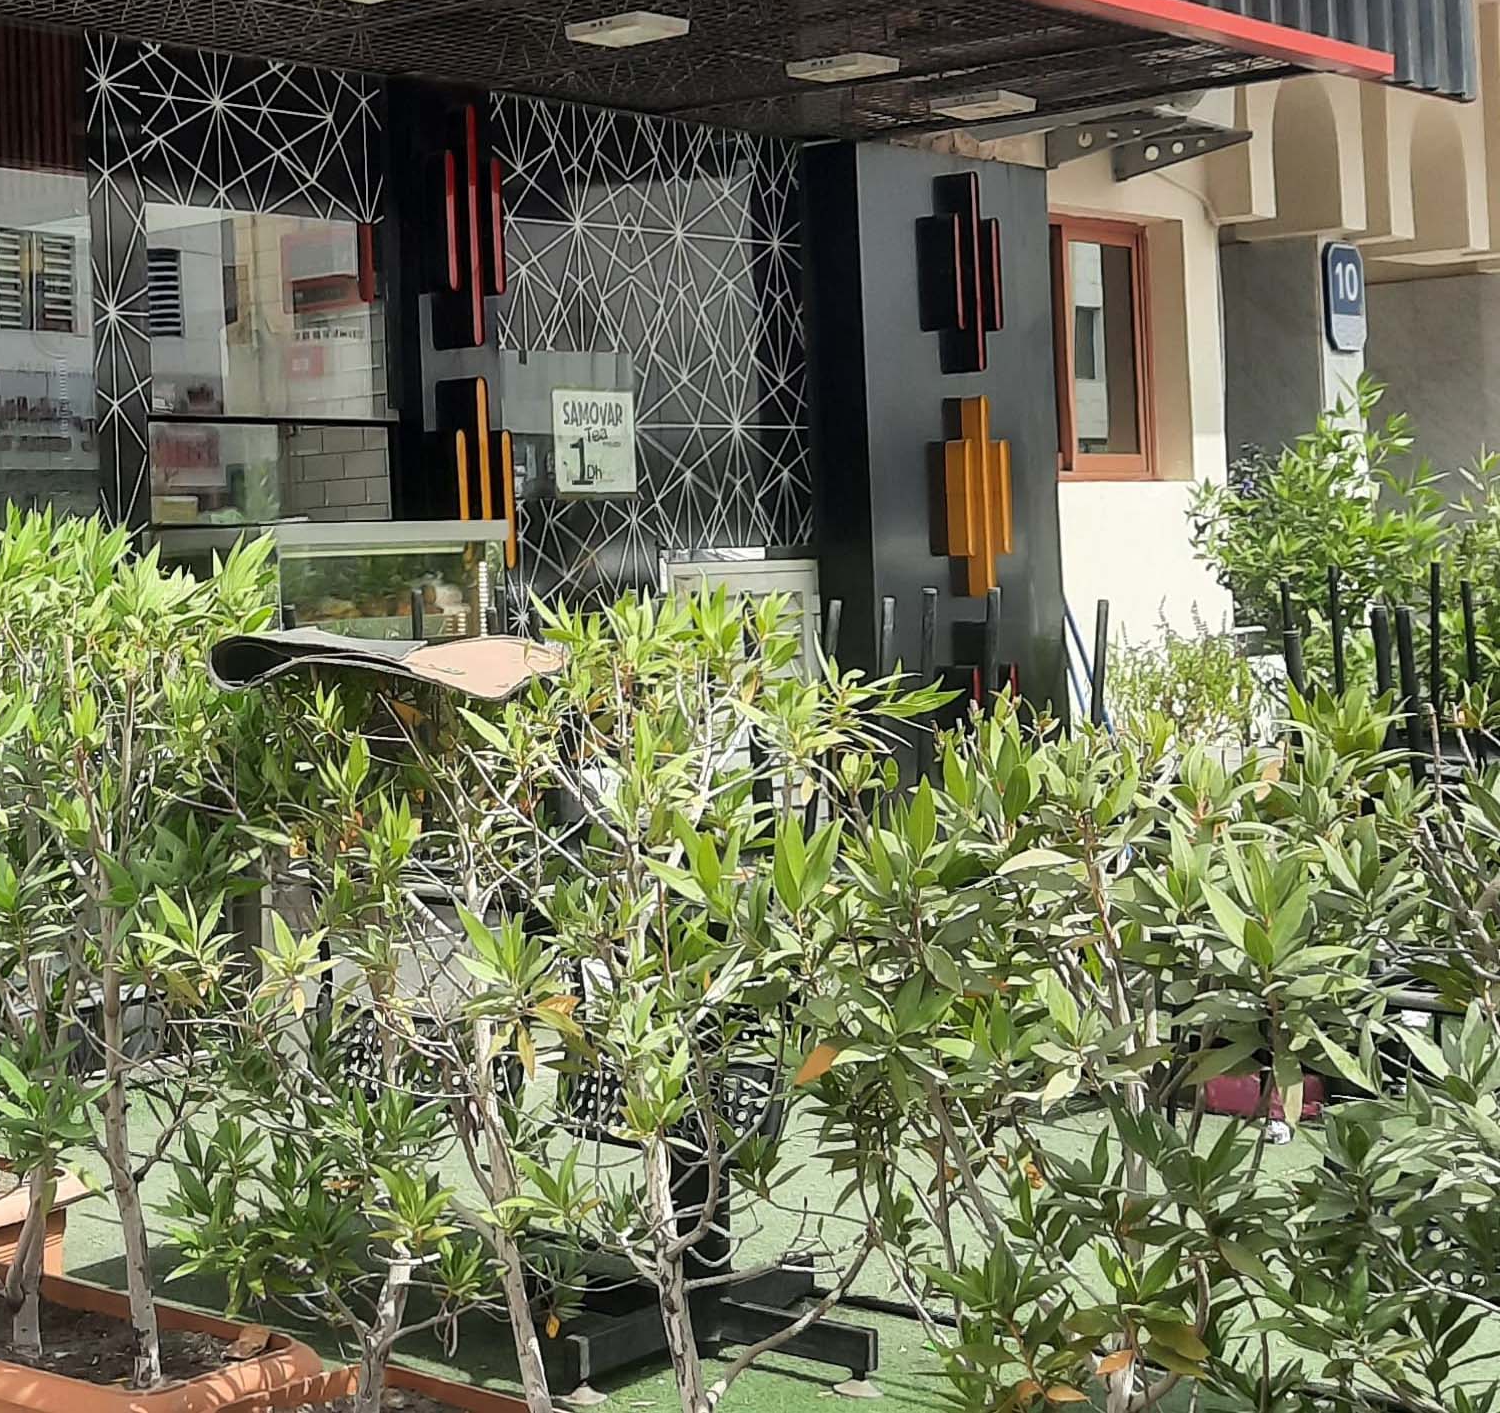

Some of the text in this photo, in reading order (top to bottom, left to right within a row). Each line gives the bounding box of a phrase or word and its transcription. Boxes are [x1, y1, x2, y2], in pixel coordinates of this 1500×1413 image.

[1335, 261, 1359, 301] 10
[563, 401, 622, 426] SAMOVAR
[584, 427, 608, 442] Tea
[570, 437, 603, 485] 1 Dh
